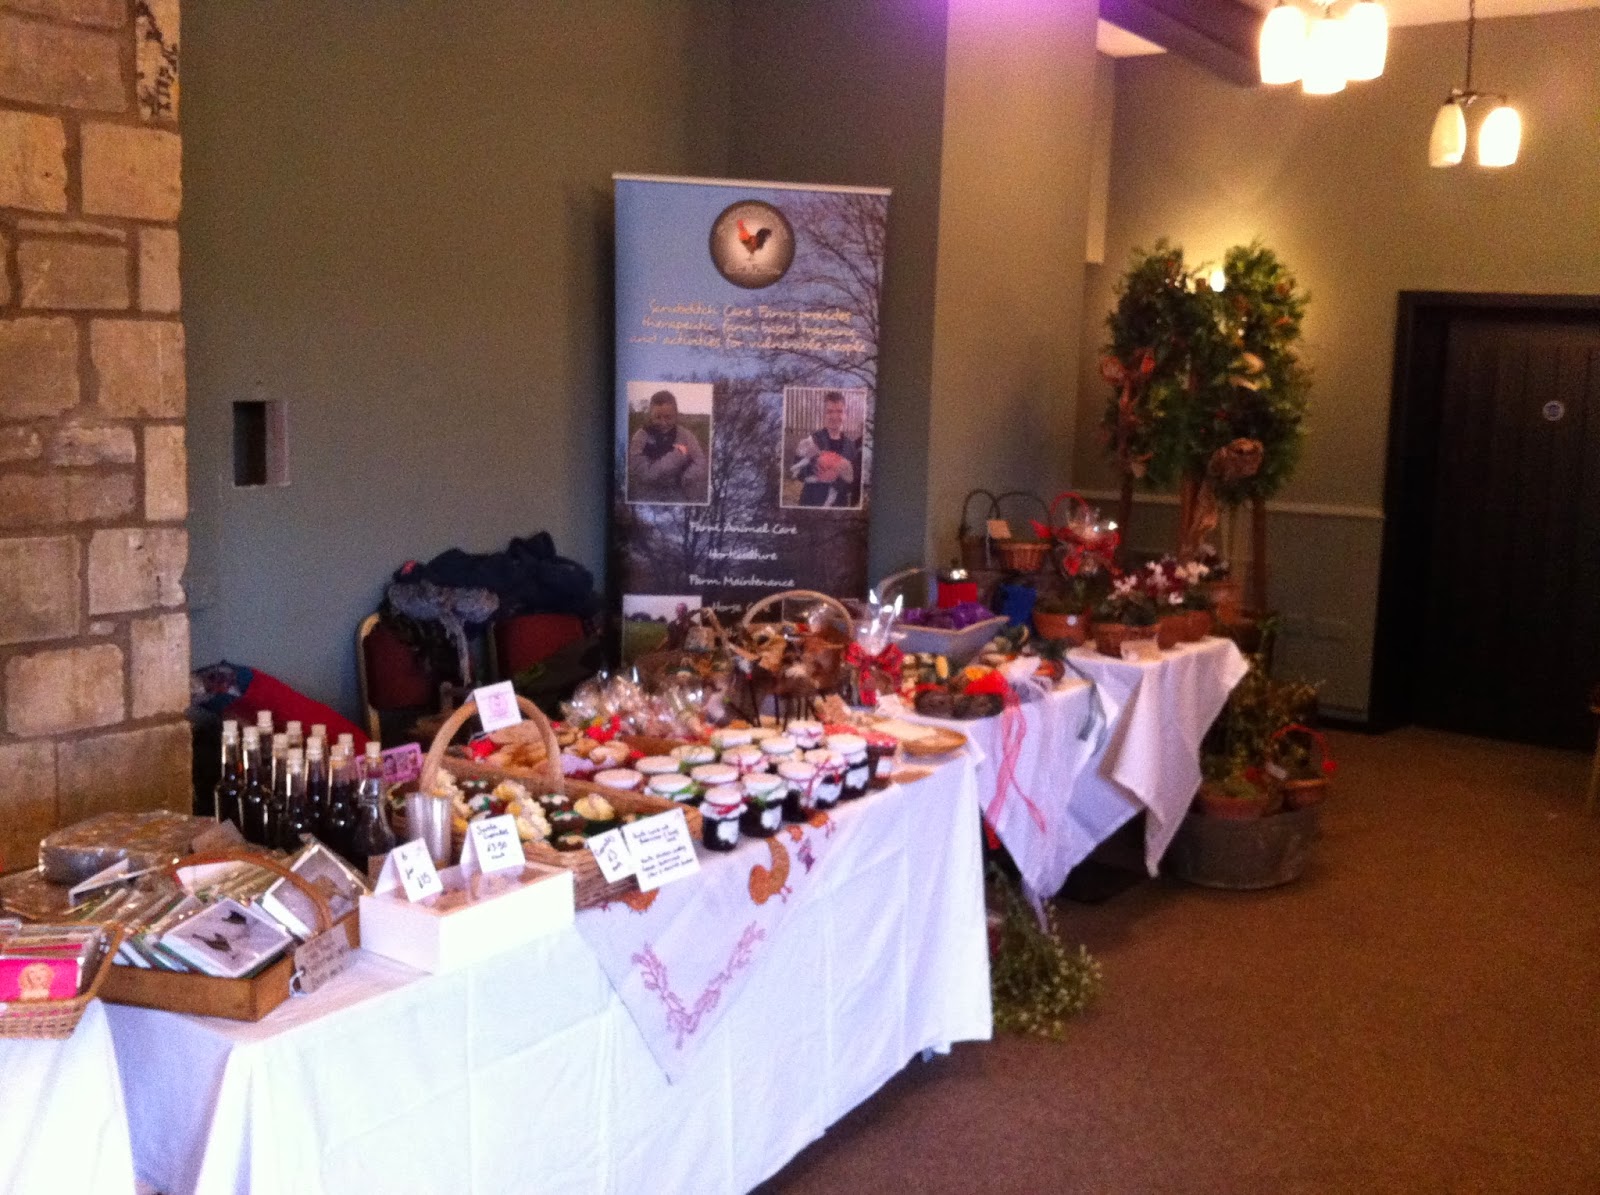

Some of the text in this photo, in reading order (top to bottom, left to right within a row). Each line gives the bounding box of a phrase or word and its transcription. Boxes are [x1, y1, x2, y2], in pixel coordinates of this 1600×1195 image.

[723, 522, 770, 534] Animal
[772, 523, 798, 535] Care
[723, 574, 795, 588] Maintenance
